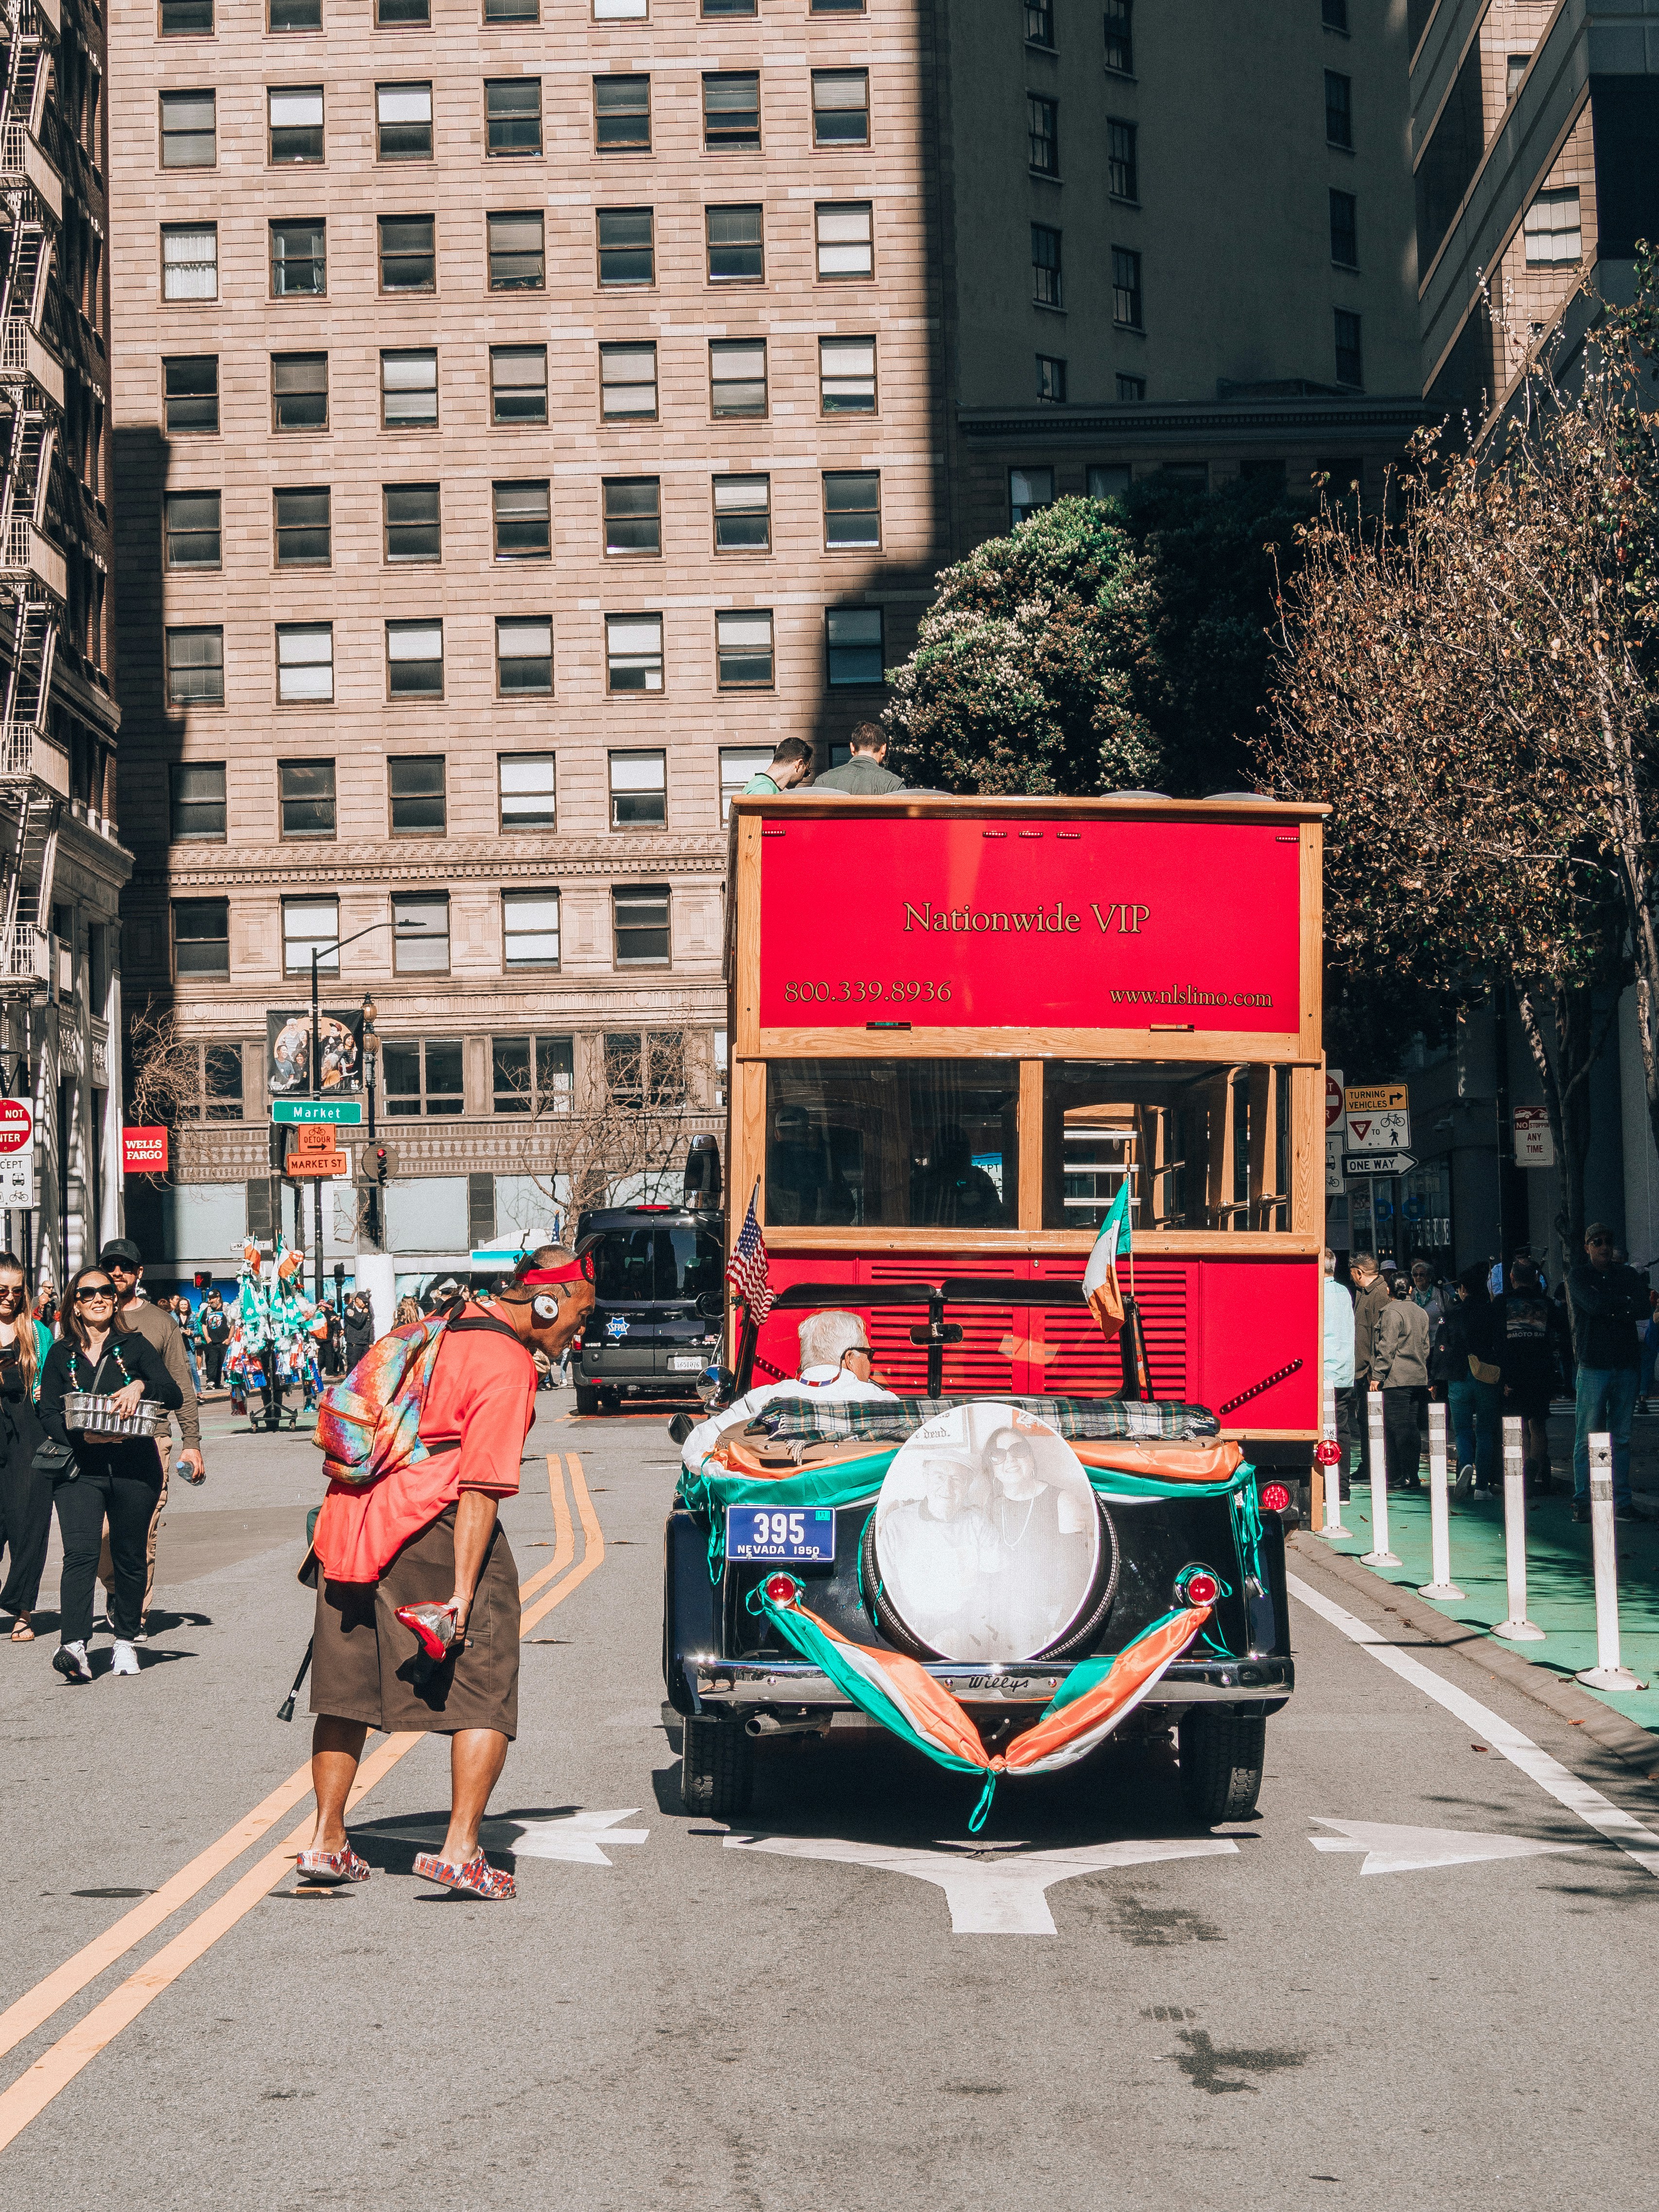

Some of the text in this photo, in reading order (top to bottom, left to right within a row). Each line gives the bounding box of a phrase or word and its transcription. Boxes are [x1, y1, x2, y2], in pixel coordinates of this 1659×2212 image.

[903, 902, 1150, 933] Nationwide VIP
[785, 980, 951, 1002] 800.339.8936
[1109, 983, 1274, 1007] www.nlslimo.com
[1349, 1090, 1385, 1099] TURNING
[1349, 1100, 1387, 1109] VEHICLES
[5, 1109, 24, 1118] NOT
[293, 1107, 341, 1118] Market
[0, 1133, 21, 1143] NTER
[1527, 1133, 1541, 1141] ANY
[125, 1139, 162, 1149] WELLS
[1526, 1145, 1543, 1153] TIME
[126, 1150, 163, 1160] FARGO
[0, 1160, 23, 1169] CEPT
[291, 1159, 342, 1169] MARKET ST
[1349, 1159, 1395, 1171] ONE WAY
[753, 1513, 805, 1544] 395
[737, 1545, 820, 1555] NEVADA 1950
[968, 1676, 1029, 1692] Willys
